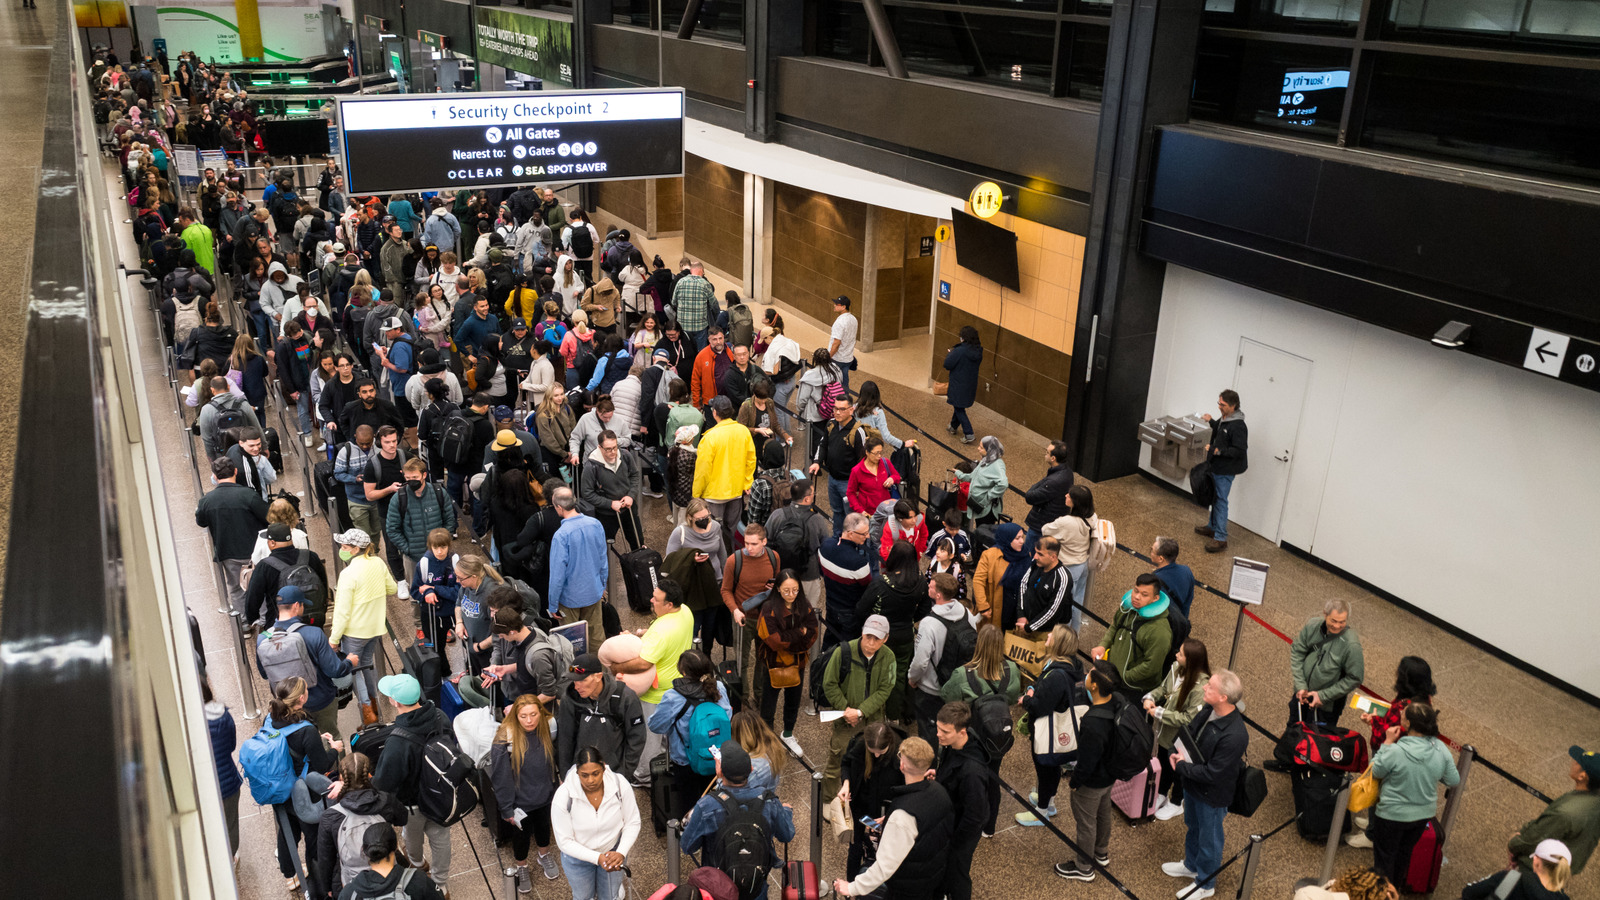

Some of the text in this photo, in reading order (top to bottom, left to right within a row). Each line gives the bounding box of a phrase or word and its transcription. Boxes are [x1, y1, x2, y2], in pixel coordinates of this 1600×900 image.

[478, 25, 538, 48] TOTALLY WORTH THE TRIP
[486, 40, 501, 52] EATERIES
[502, 43, 510, 54] AND
[510, 45, 524, 57] SHOPS
[524, 49, 538, 61] AHEAD
[449, 102, 609, 121] Security Checkpoint 2
[506, 128, 560, 140] All Gates
[453, 149, 490, 160] Nearest
[493, 149, 506, 158] to:
[529, 146, 555, 156] Gates
[458, 162, 607, 179] CLEAR SEA SPOT SAVER
[1009, 644, 1035, 664] NIKE
